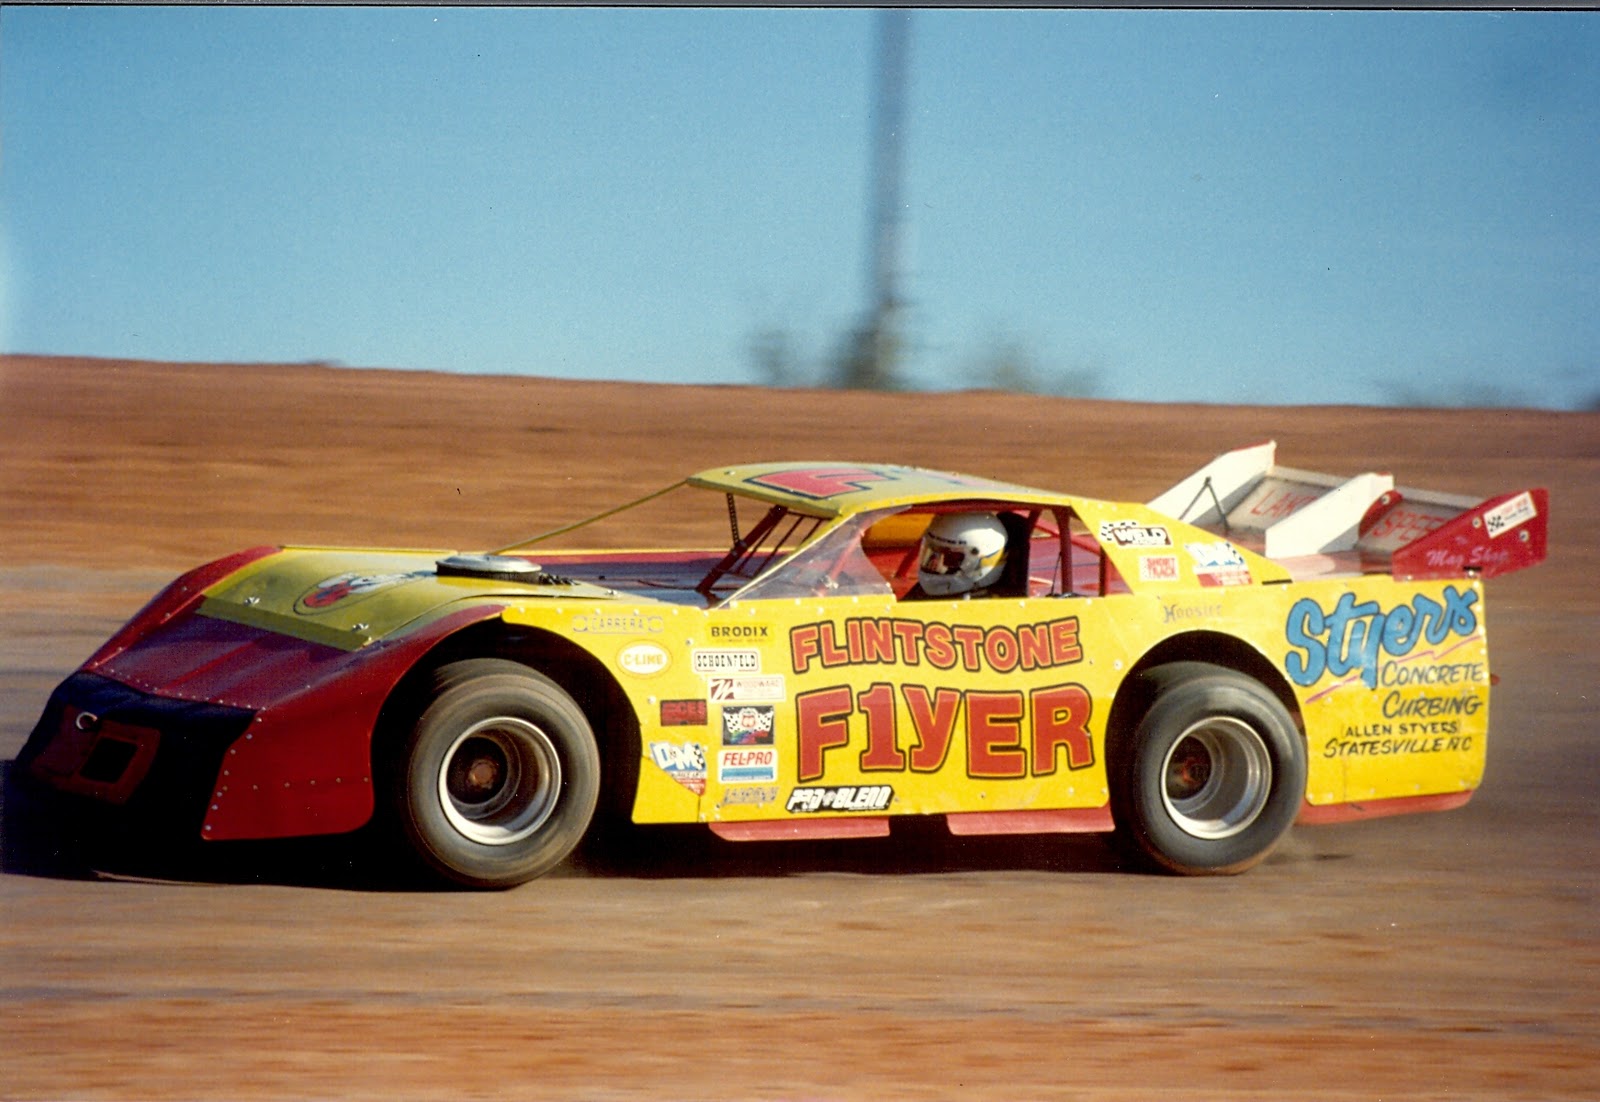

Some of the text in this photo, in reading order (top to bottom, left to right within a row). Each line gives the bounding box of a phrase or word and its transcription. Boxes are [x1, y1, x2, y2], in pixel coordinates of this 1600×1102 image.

[711, 626, 768, 637] BRODIX
[1285, 585, 1480, 690] Styers
[790, 616, 1083, 673] FLINTSTONE
[697, 654, 756, 668] SCHOENFELD
[1381, 661, 1484, 687] CONCRETE
[1382, 691, 1483, 719] CURBING
[796, 682, 1095, 783] F1YER
[1345, 721, 1459, 738] ALLEN STYERS
[723, 751, 773, 766] FEL-PRO
[1323, 737, 1444, 758] STATESVILLE
